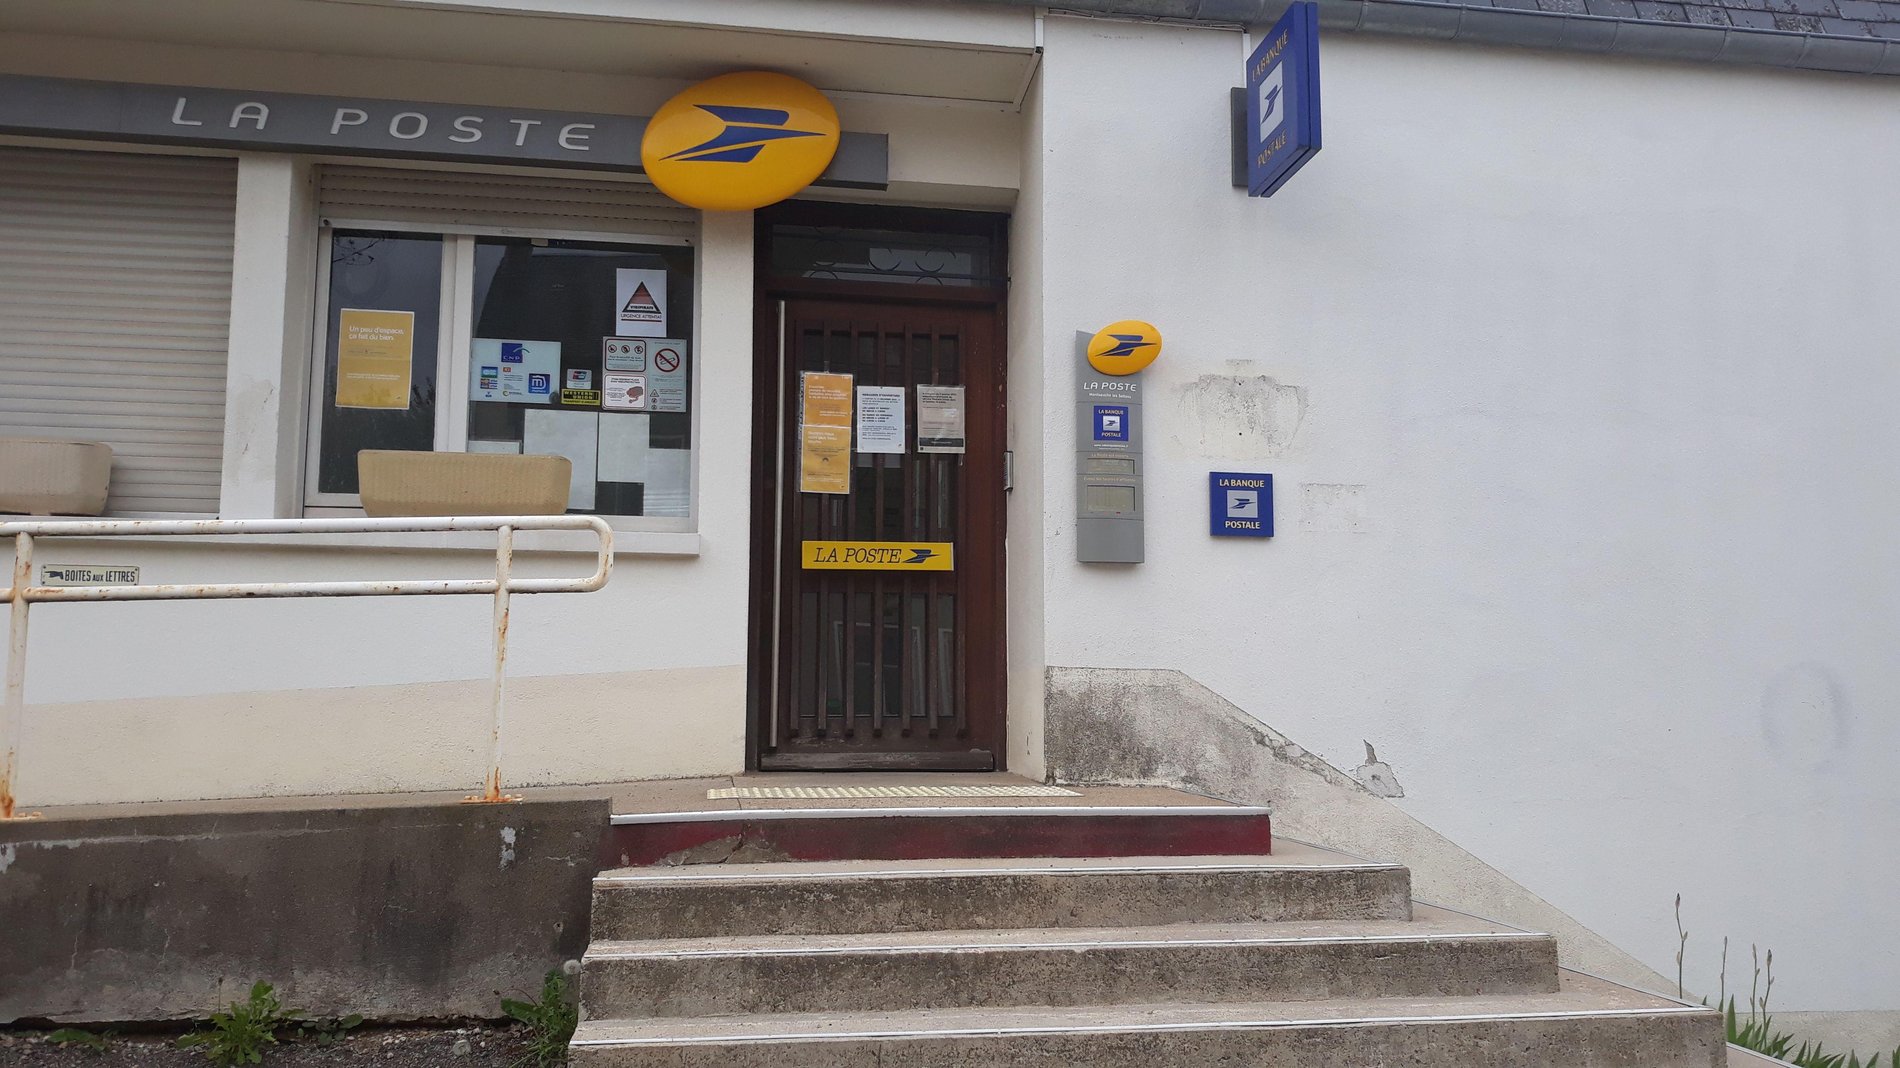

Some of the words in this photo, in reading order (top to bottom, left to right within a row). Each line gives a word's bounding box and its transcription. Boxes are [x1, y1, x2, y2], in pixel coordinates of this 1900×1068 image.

[1260, 28, 1288, 72] BANQUE
[170, 97, 270, 130] LA
[329, 107, 597, 151] POSTE
[1258, 130, 1287, 169] POSTALE
[1084, 382, 1098, 390] LA
[1101, 382, 1136, 392] POSTE
[1231, 479, 1264, 488] BANQUE
[1225, 521, 1260, 529] POSTALE
[813, 548, 838, 562] LA
[843, 548, 902, 563] POSTE
[65, 570, 92, 581] BOITES
[105, 571, 135, 582] LETTRES
